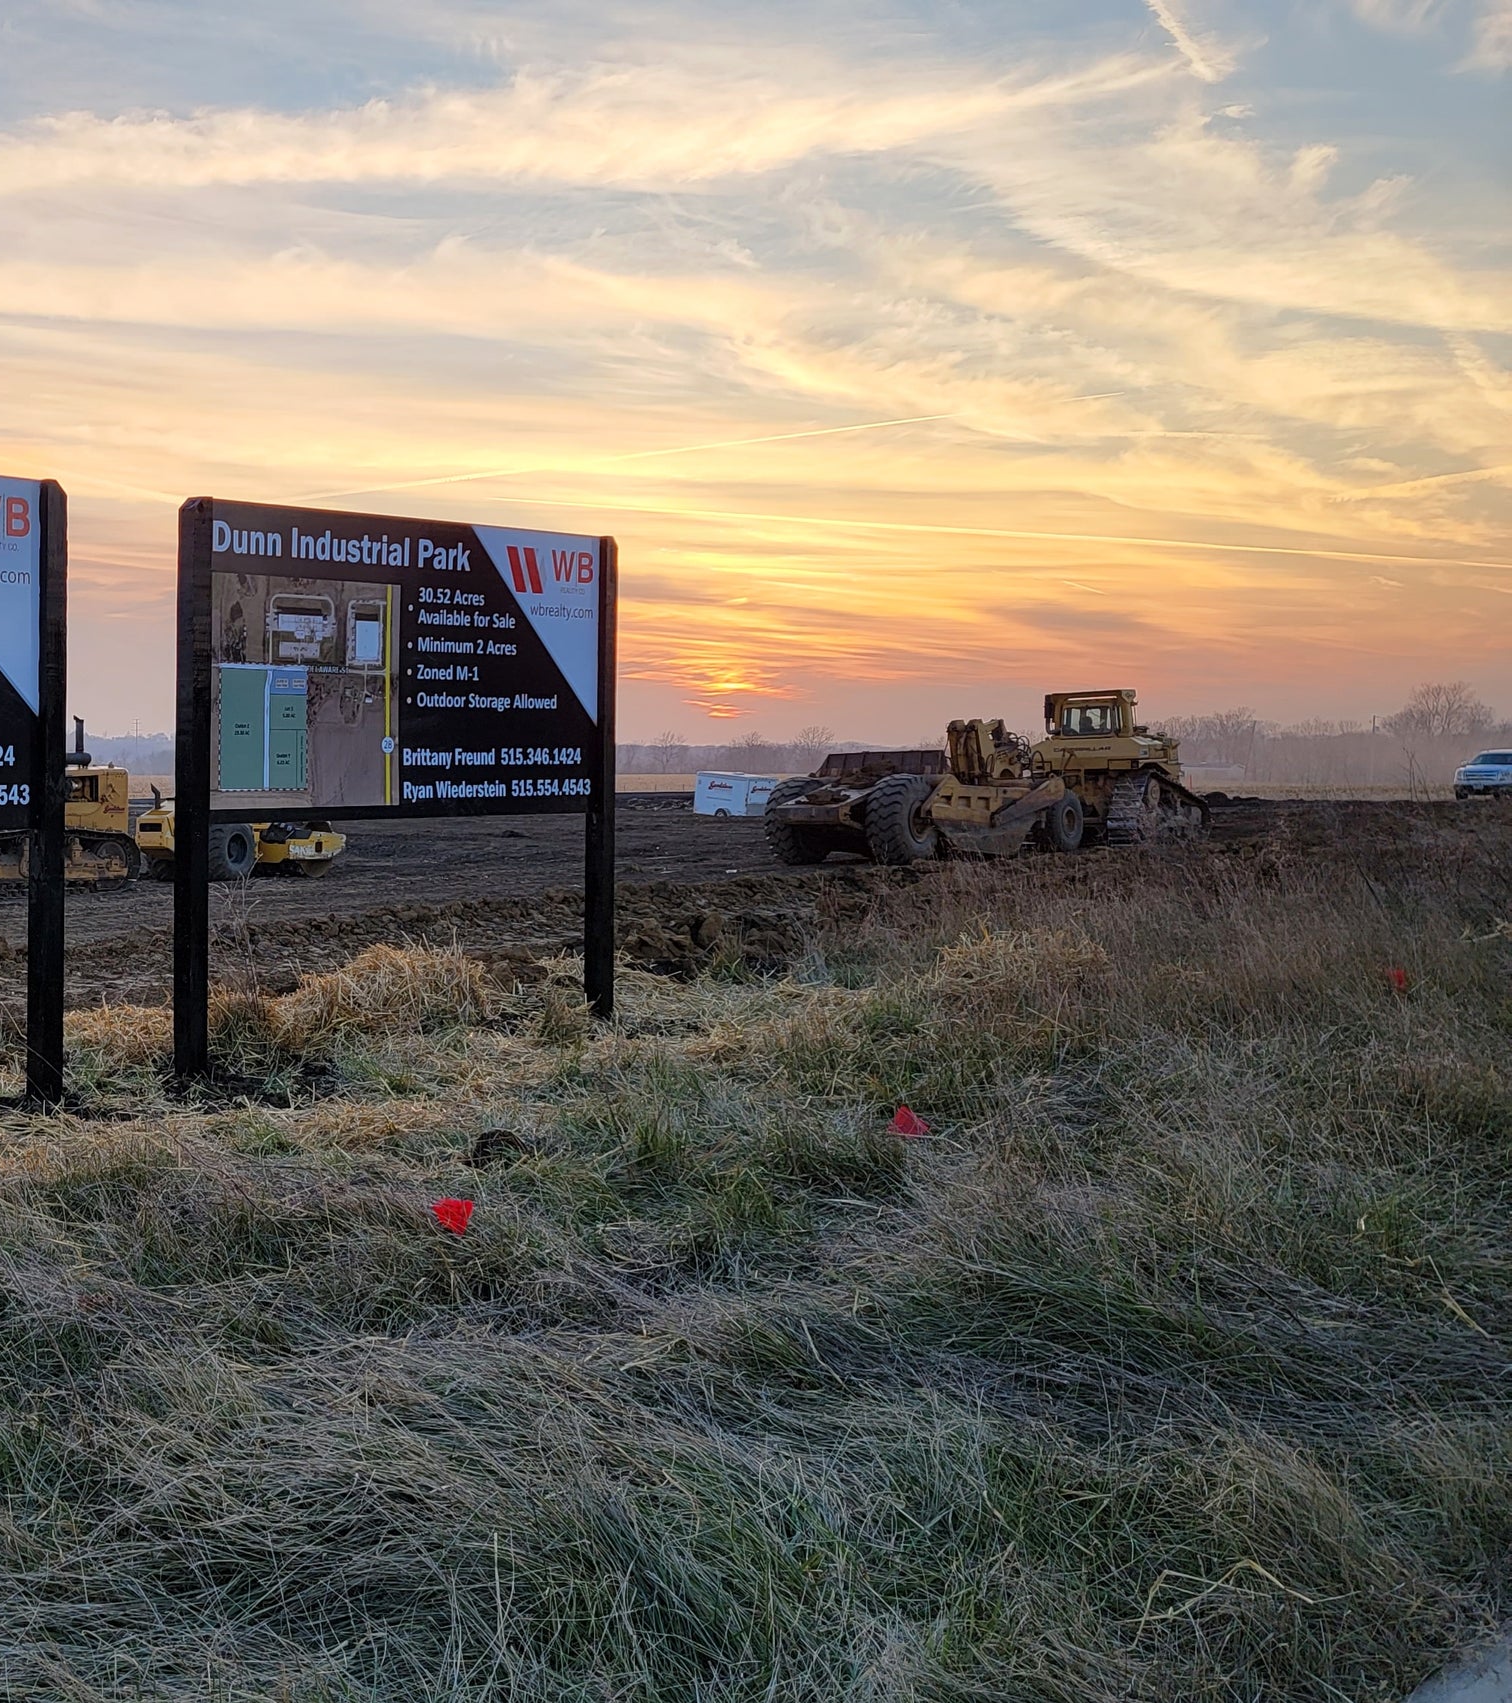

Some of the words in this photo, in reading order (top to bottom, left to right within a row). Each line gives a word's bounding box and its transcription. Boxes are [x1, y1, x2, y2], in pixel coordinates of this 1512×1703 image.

[213, 520, 282, 557] Dunn
[291, 527, 410, 568] Industrial
[418, 539, 471, 573] Park
[551, 549, 594, 584] WB
[418, 587, 452, 605] 30.52
[454, 589, 485, 607] Acres
[417, 608, 471, 628] Available
[472, 613, 491, 628] for
[492, 614, 516, 630] Sale
[530, 603, 594, 621] wbrealty.com
[417, 637, 474, 655] Minimum
[476, 639, 485, 655] 2
[486, 641, 517, 657] Acres
[416, 665, 452, 682] Zoned
[455, 665, 479, 682] M-1
[416, 692, 466, 709] Outdoor
[469, 692, 511, 712] Storage
[513, 693, 557, 710] Allowed
[383, 739, 393, 750] 28
[402, 748, 452, 770] Brittany
[455, 748, 495, 767] Freund
[501, 747, 581, 766] 515.346.1424
[403, 783, 433, 802] Ryan
[435, 780, 506, 798] Wiederstein
[511, 778, 591, 797] 515.554.4543
